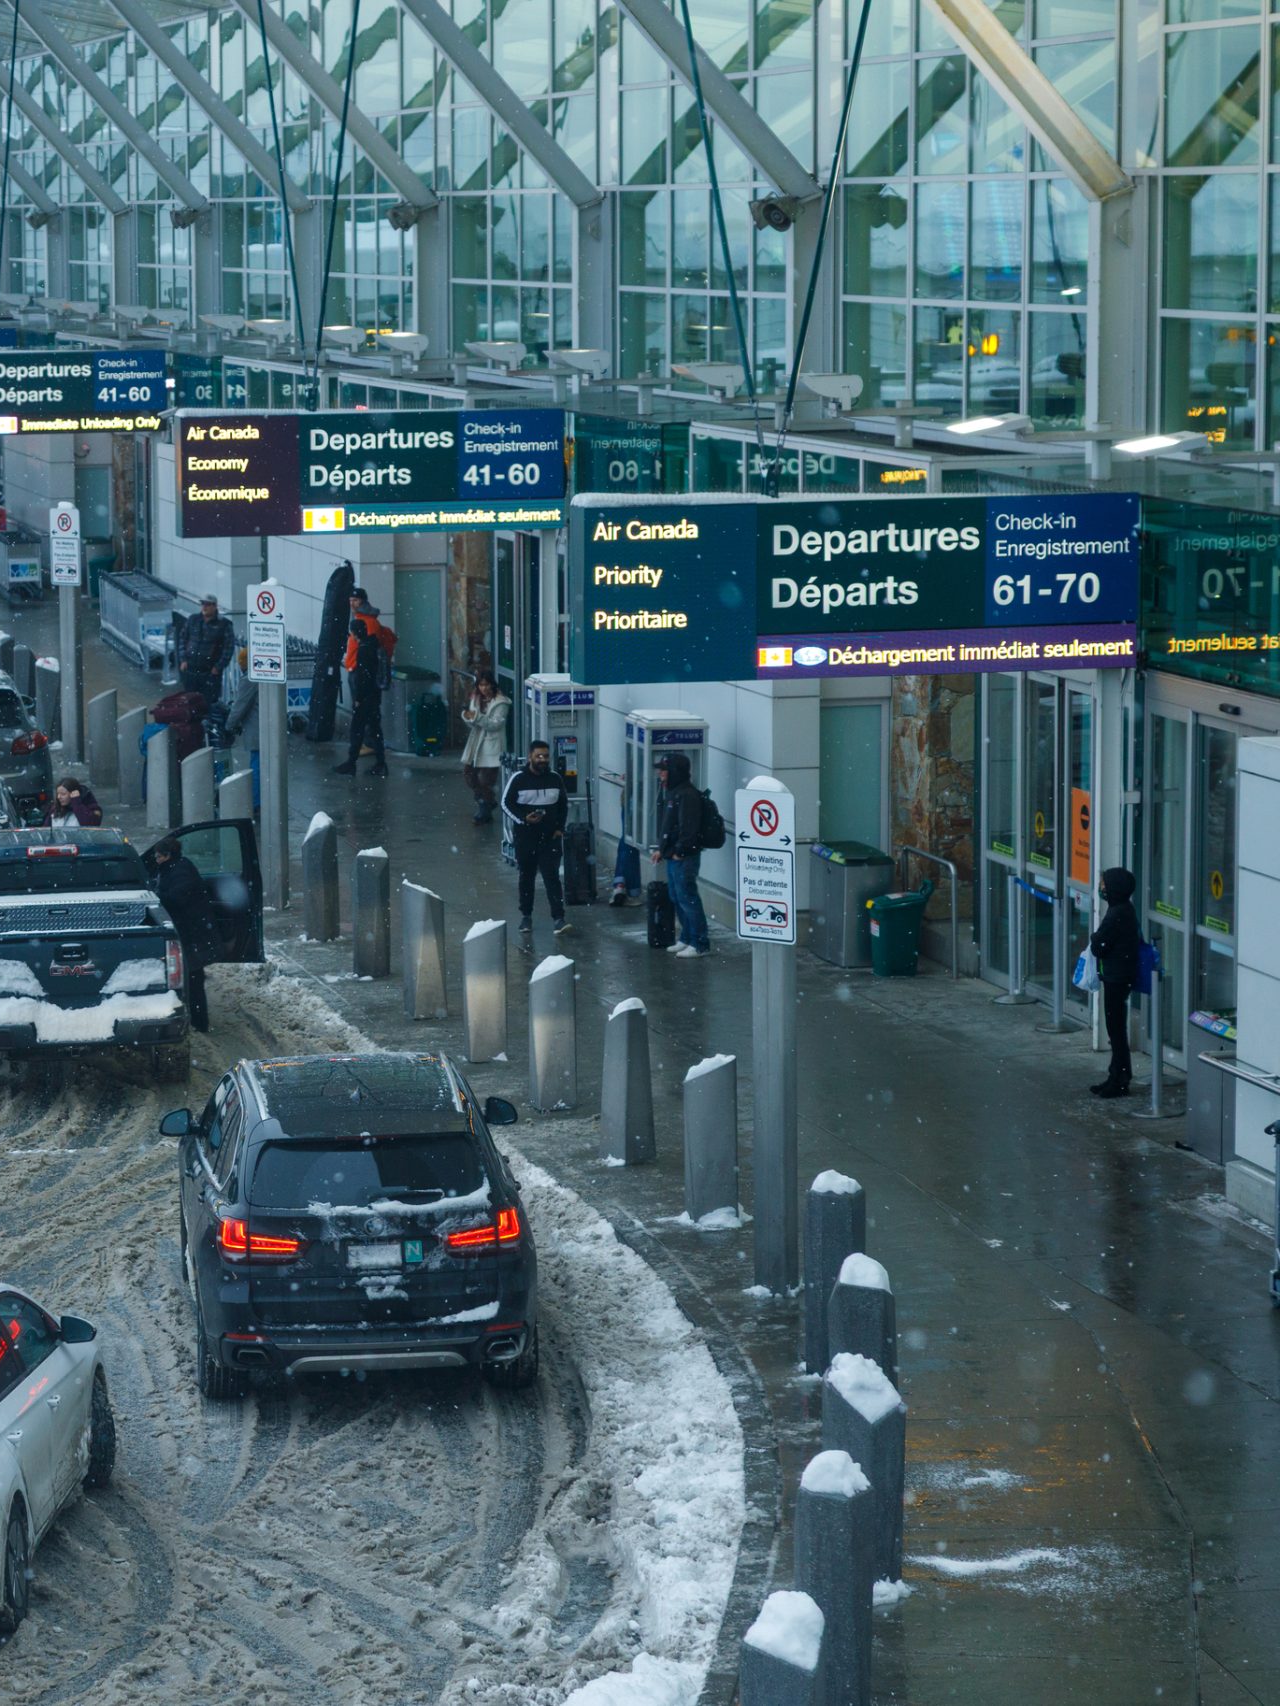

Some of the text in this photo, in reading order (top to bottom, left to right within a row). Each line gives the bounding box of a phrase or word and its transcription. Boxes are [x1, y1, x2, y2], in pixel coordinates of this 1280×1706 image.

[98, 358, 138, 368] Check-in
[98, 370, 164, 381] Enregistrement
[97, 386, 151, 403] 41-60
[22, 419, 78, 432] Immediate
[135, 415, 160, 430] Only
[186, 424, 260, 441] Air Canada
[464, 422, 522, 437] Check-in
[310, 428, 454, 455] Departures
[464, 439, 558, 456] Enregistrement
[187, 456, 249, 473] Economy
[463, 462, 540, 486] 41-60
[309, 463, 412, 491] Départs
[188, 483, 270, 503] Économique
[349, 507, 562, 528] Déchargement immédiat seulement
[995, 512, 1076, 531] Check-in
[593, 518, 699, 541] Air Canada
[773, 523, 980, 562] Departures
[995, 537, 1130, 560] Enregistrement
[594, 564, 663, 588] Priority
[772, 571, 919, 614] Départs
[993, 572, 1100, 606] 61-70
[594, 609, 688, 630] Prioritaire
[828, 639, 1133, 669] Déchargement immédiat seulement
[747, 854, 784, 866] No Waiting
[743, 877, 788, 889] Pas d'attente
[49, 964, 96, 977] GMC
[407, 1243, 419, 1255] N
